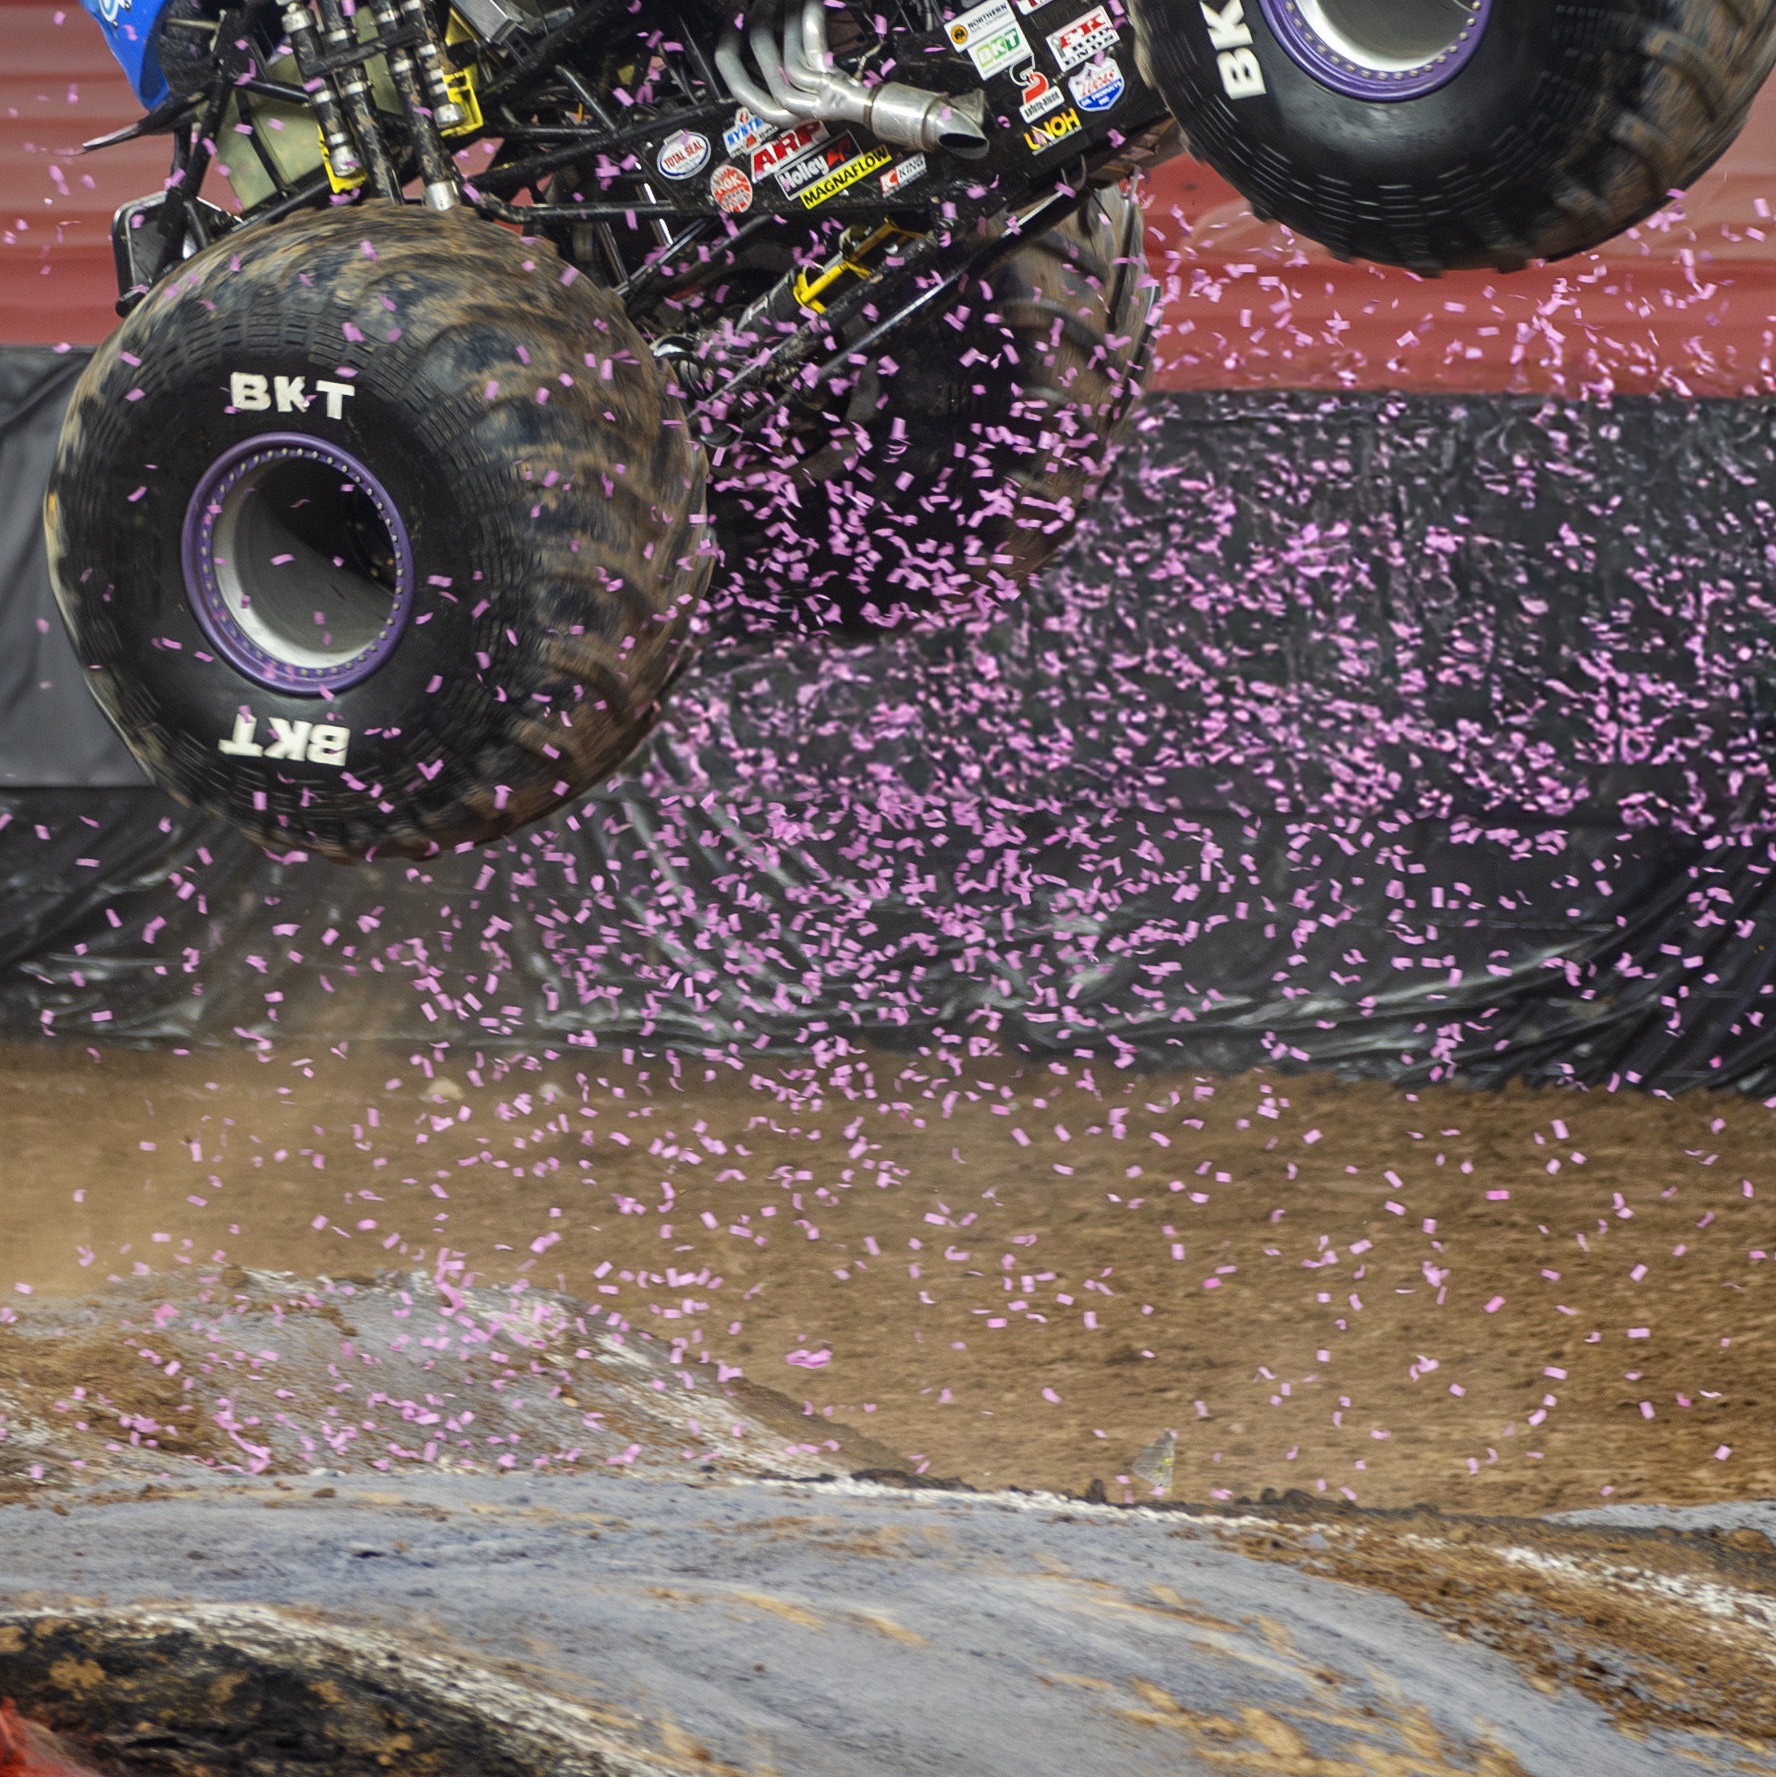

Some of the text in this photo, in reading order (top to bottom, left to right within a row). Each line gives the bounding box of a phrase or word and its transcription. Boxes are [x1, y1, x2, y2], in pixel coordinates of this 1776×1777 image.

[967, 3, 1008, 29] NORTHERN
[1060, 13, 1106, 49] FK
[976, 27, 1021, 67] BKT
[752, 120, 824, 175] ARP
[1023, 107, 1081, 150] UNOH
[684, 142, 704, 160] SEAL
[898, 155, 925, 178] KING
[778, 154, 829, 193] Holley
[803, 146, 889, 206] MAGNAFLOW
[230, 371, 355, 420] BKT
[218, 712, 351, 767] BKT
